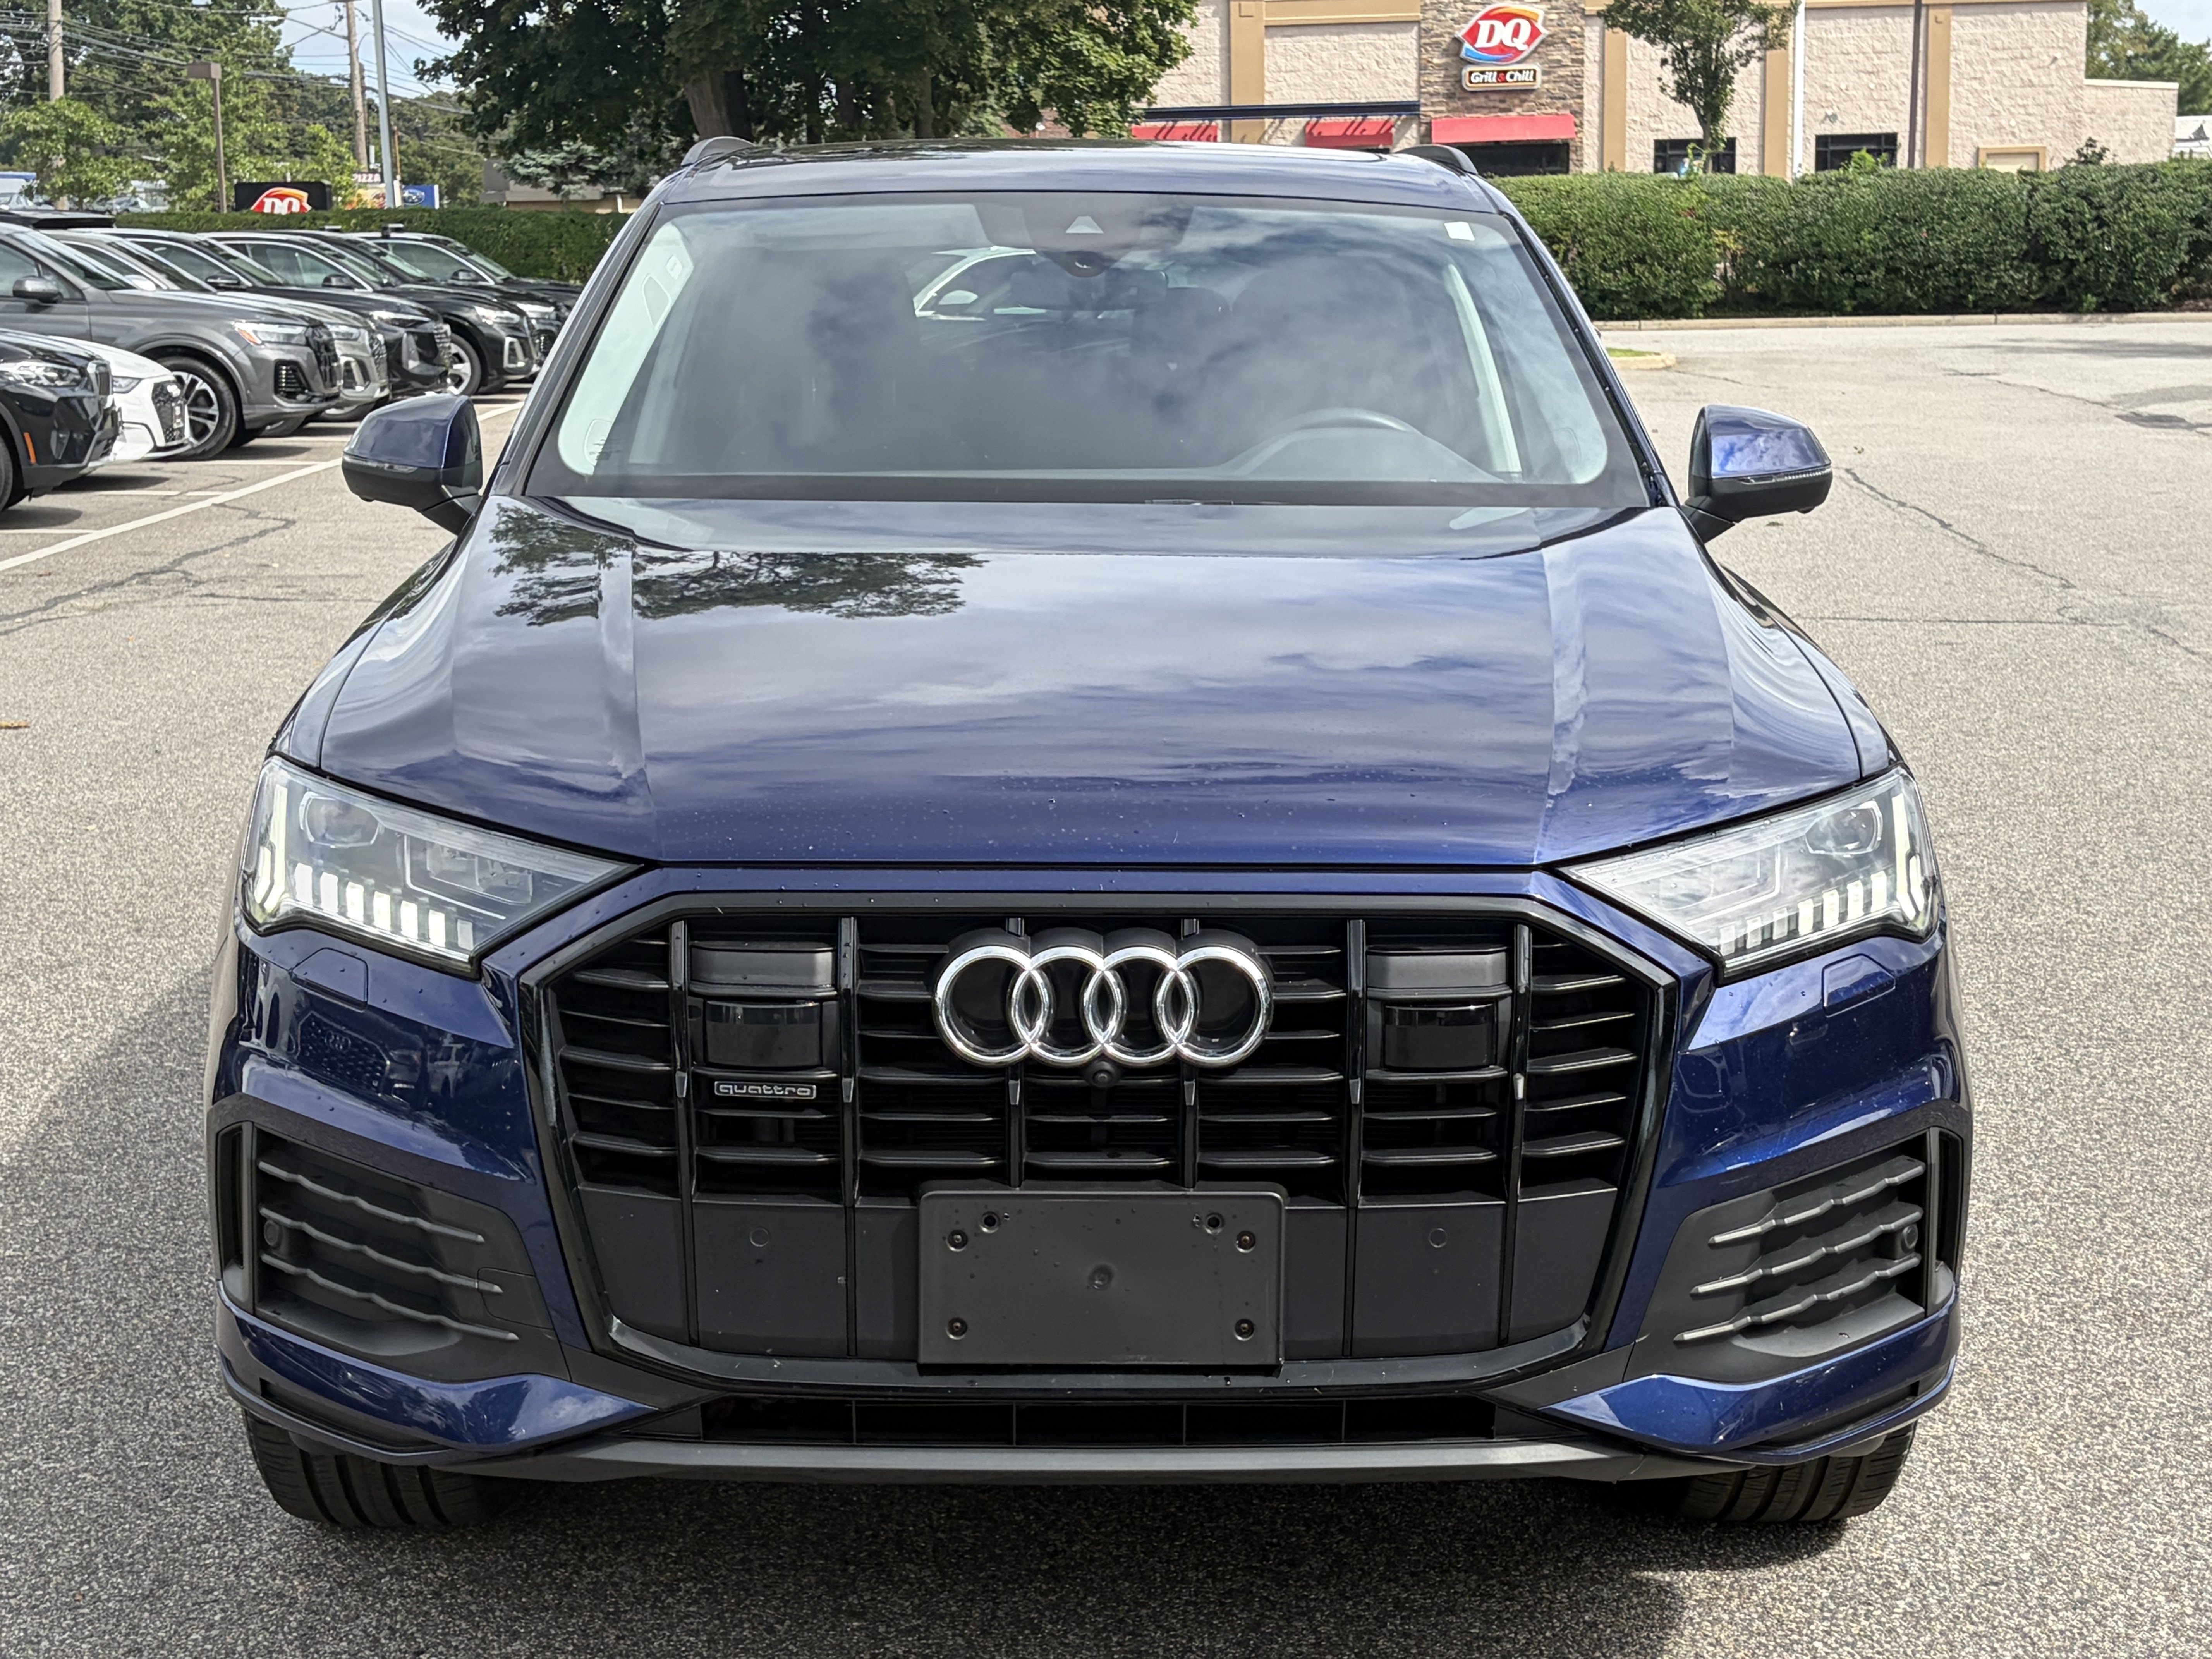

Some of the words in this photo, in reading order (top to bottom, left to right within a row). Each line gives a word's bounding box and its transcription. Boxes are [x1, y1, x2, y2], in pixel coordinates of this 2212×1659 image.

[1474, 18, 1531, 51] DQ
[1471, 71, 1497, 83] Grill
[1506, 70, 1534, 82] Chill
[719, 1085, 811, 1096] quattro
